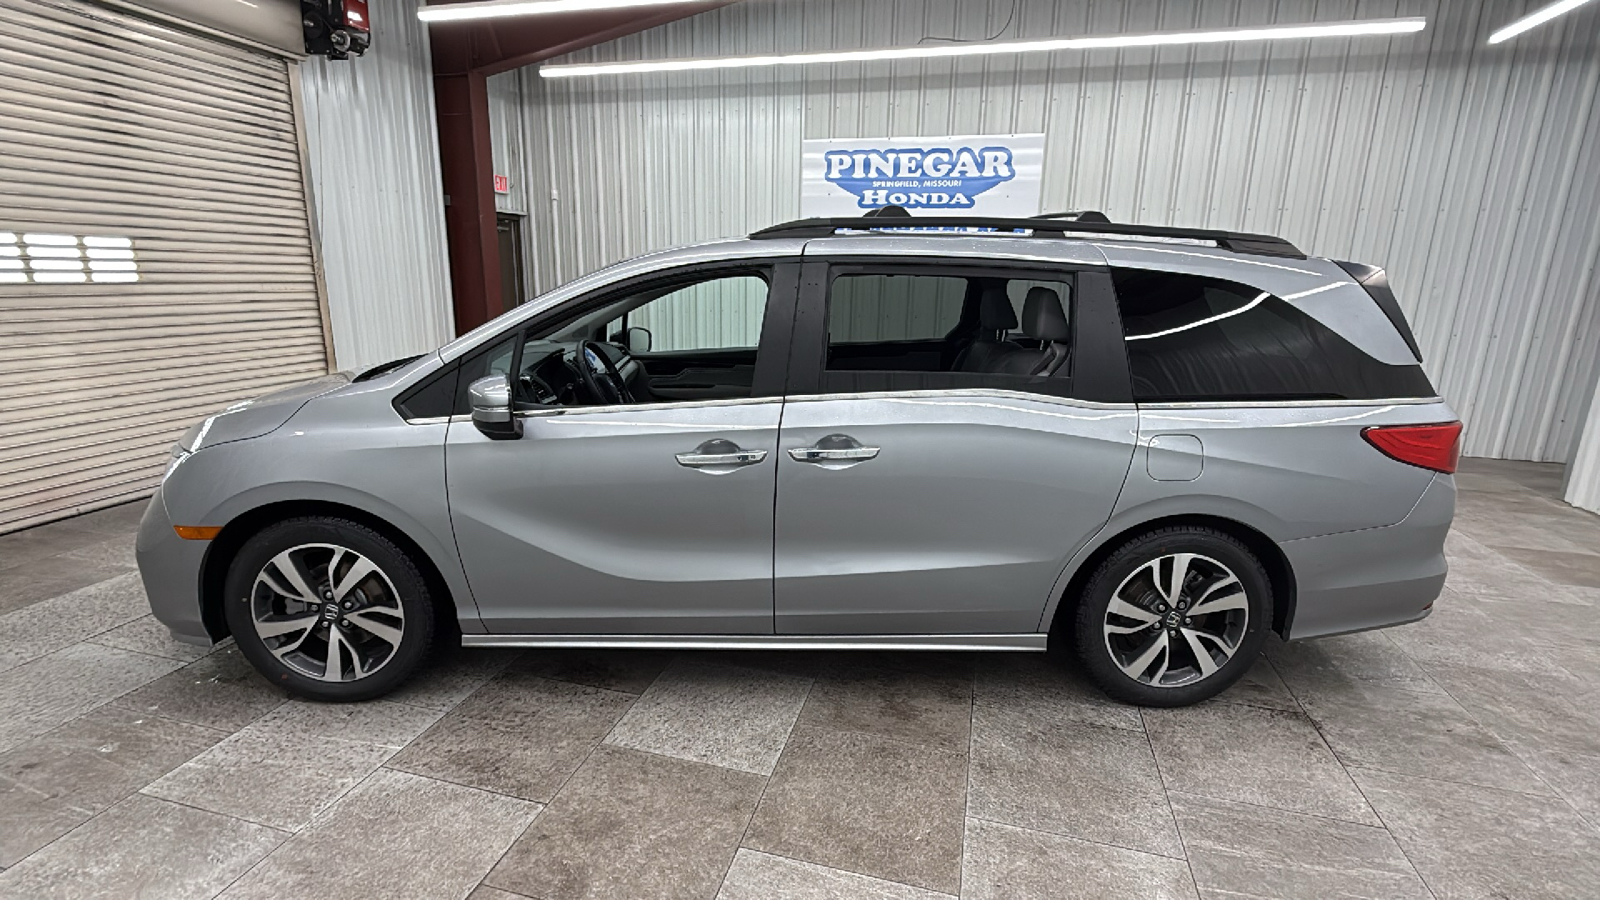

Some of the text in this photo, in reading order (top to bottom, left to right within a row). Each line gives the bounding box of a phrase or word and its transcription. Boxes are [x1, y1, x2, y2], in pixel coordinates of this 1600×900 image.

[828, 151, 1011, 178] PINEGAR
[872, 179, 962, 188] SPRINGFIELD, MISSOURI
[861, 189, 970, 205] HONDA
